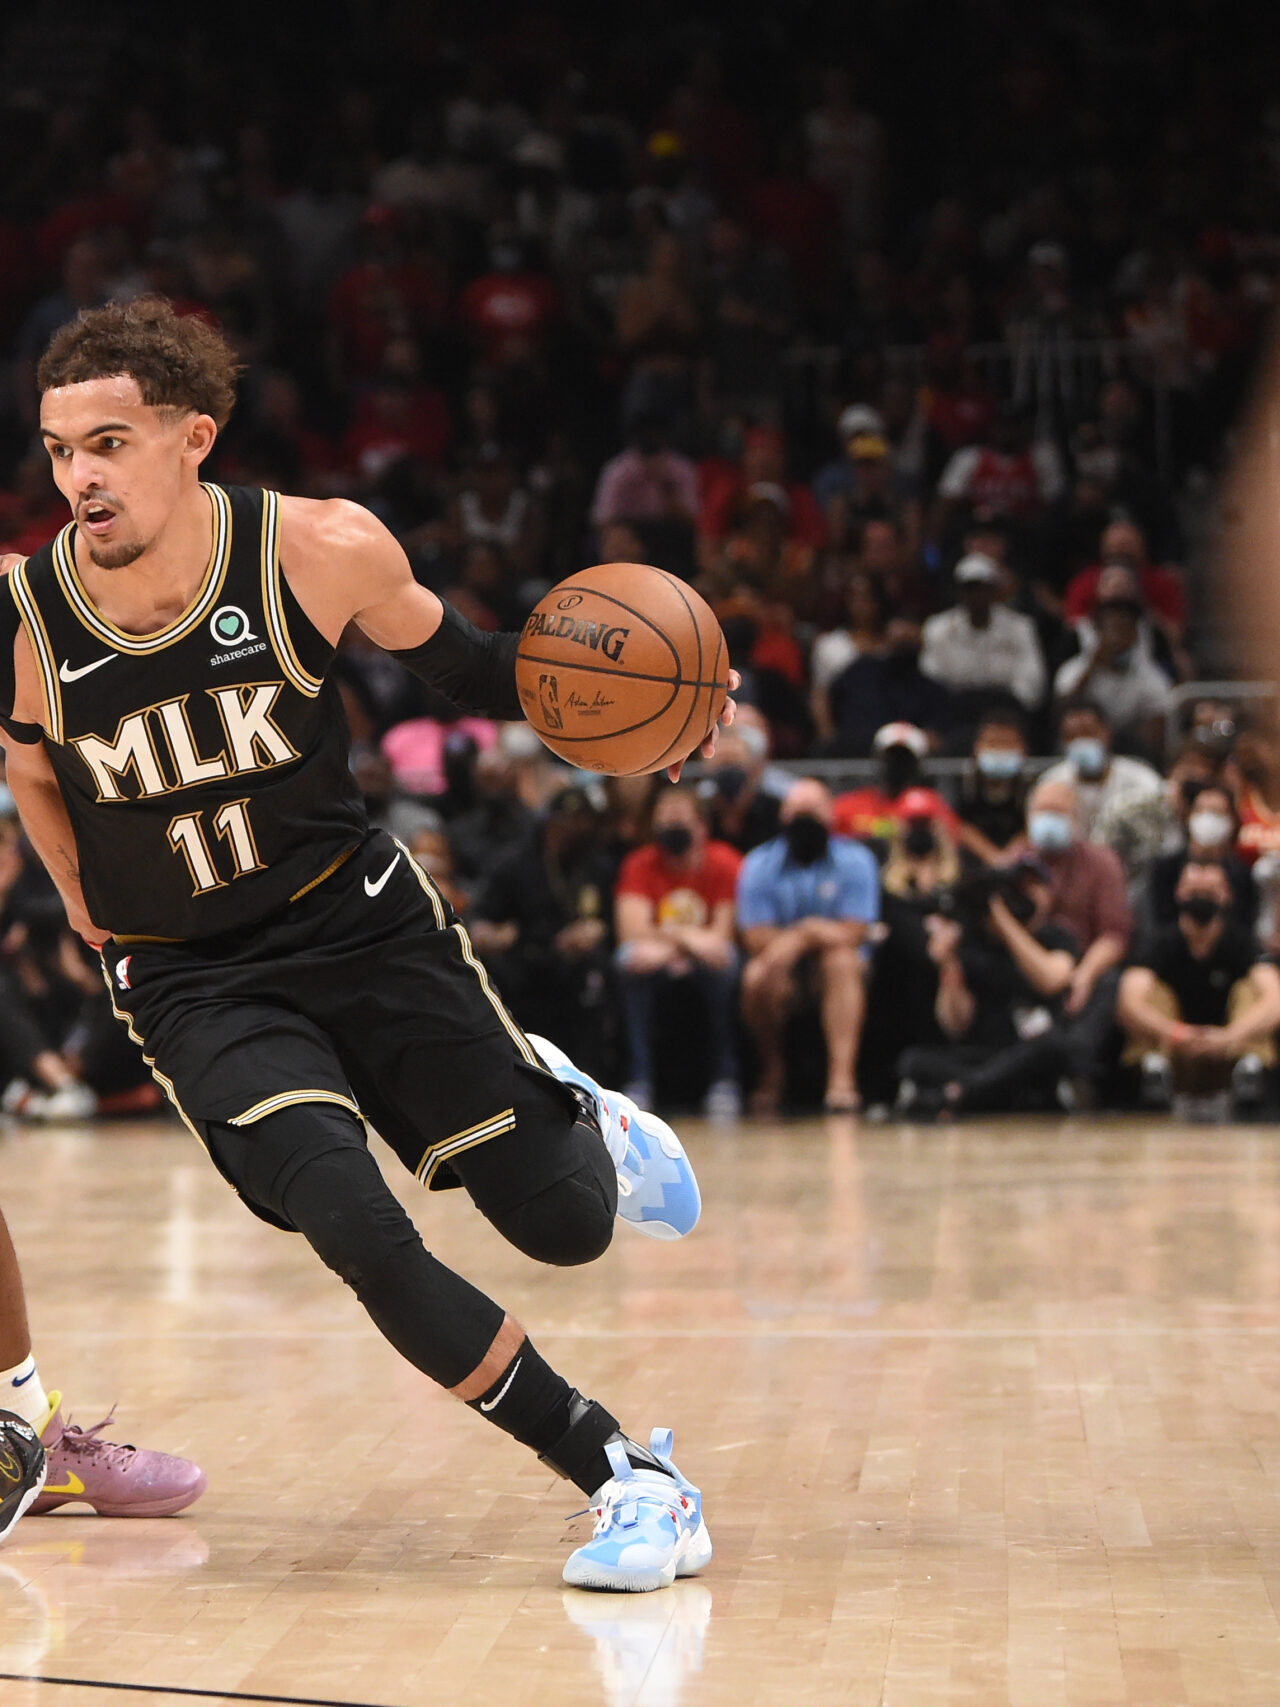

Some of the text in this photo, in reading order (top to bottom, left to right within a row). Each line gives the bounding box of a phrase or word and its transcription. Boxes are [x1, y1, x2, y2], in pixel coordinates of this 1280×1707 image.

[210, 642, 267, 666] sharecare
[67, 680, 303, 803] MLK
[166, 797, 269, 898] 11
